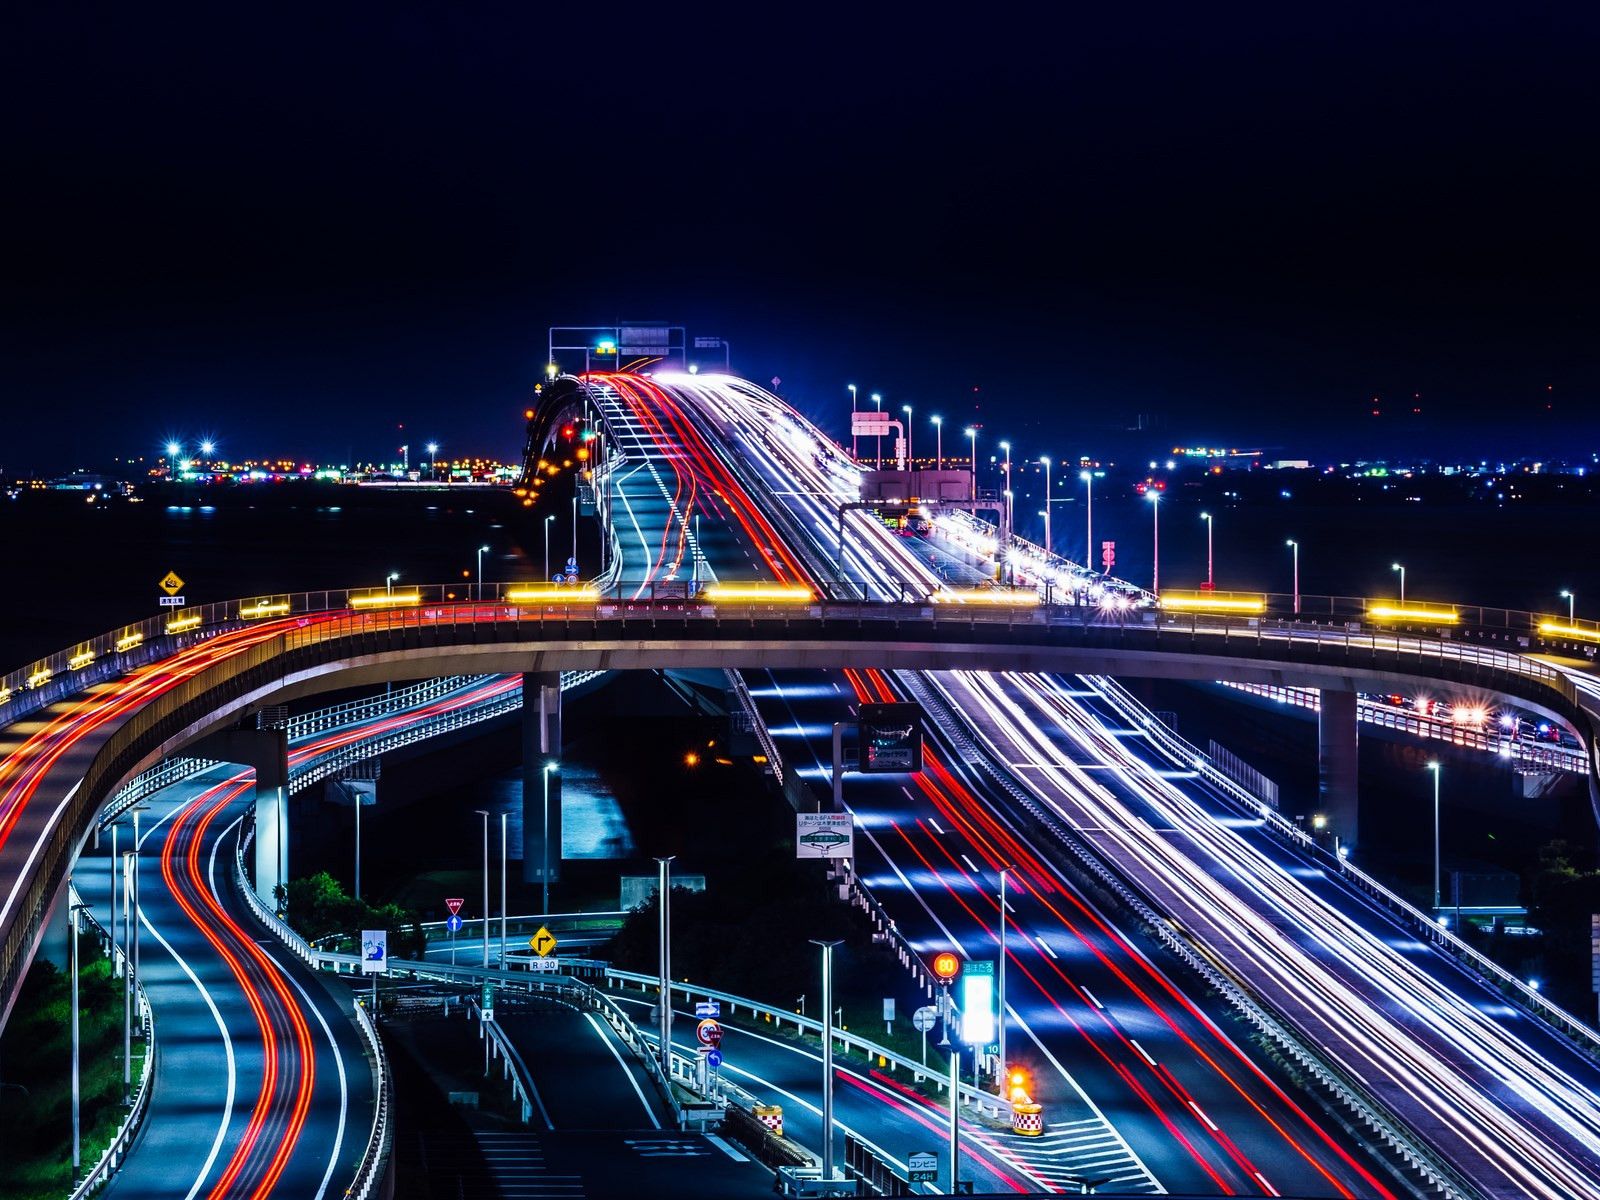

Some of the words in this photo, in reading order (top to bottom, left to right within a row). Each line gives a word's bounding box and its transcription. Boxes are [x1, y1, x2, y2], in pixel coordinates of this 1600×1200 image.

[939, 959, 954, 972] 80
[988, 1045, 998, 1054] 10
[910, 1160, 936, 1168] コンビニ
[913, 1173, 934, 1181] 24H
